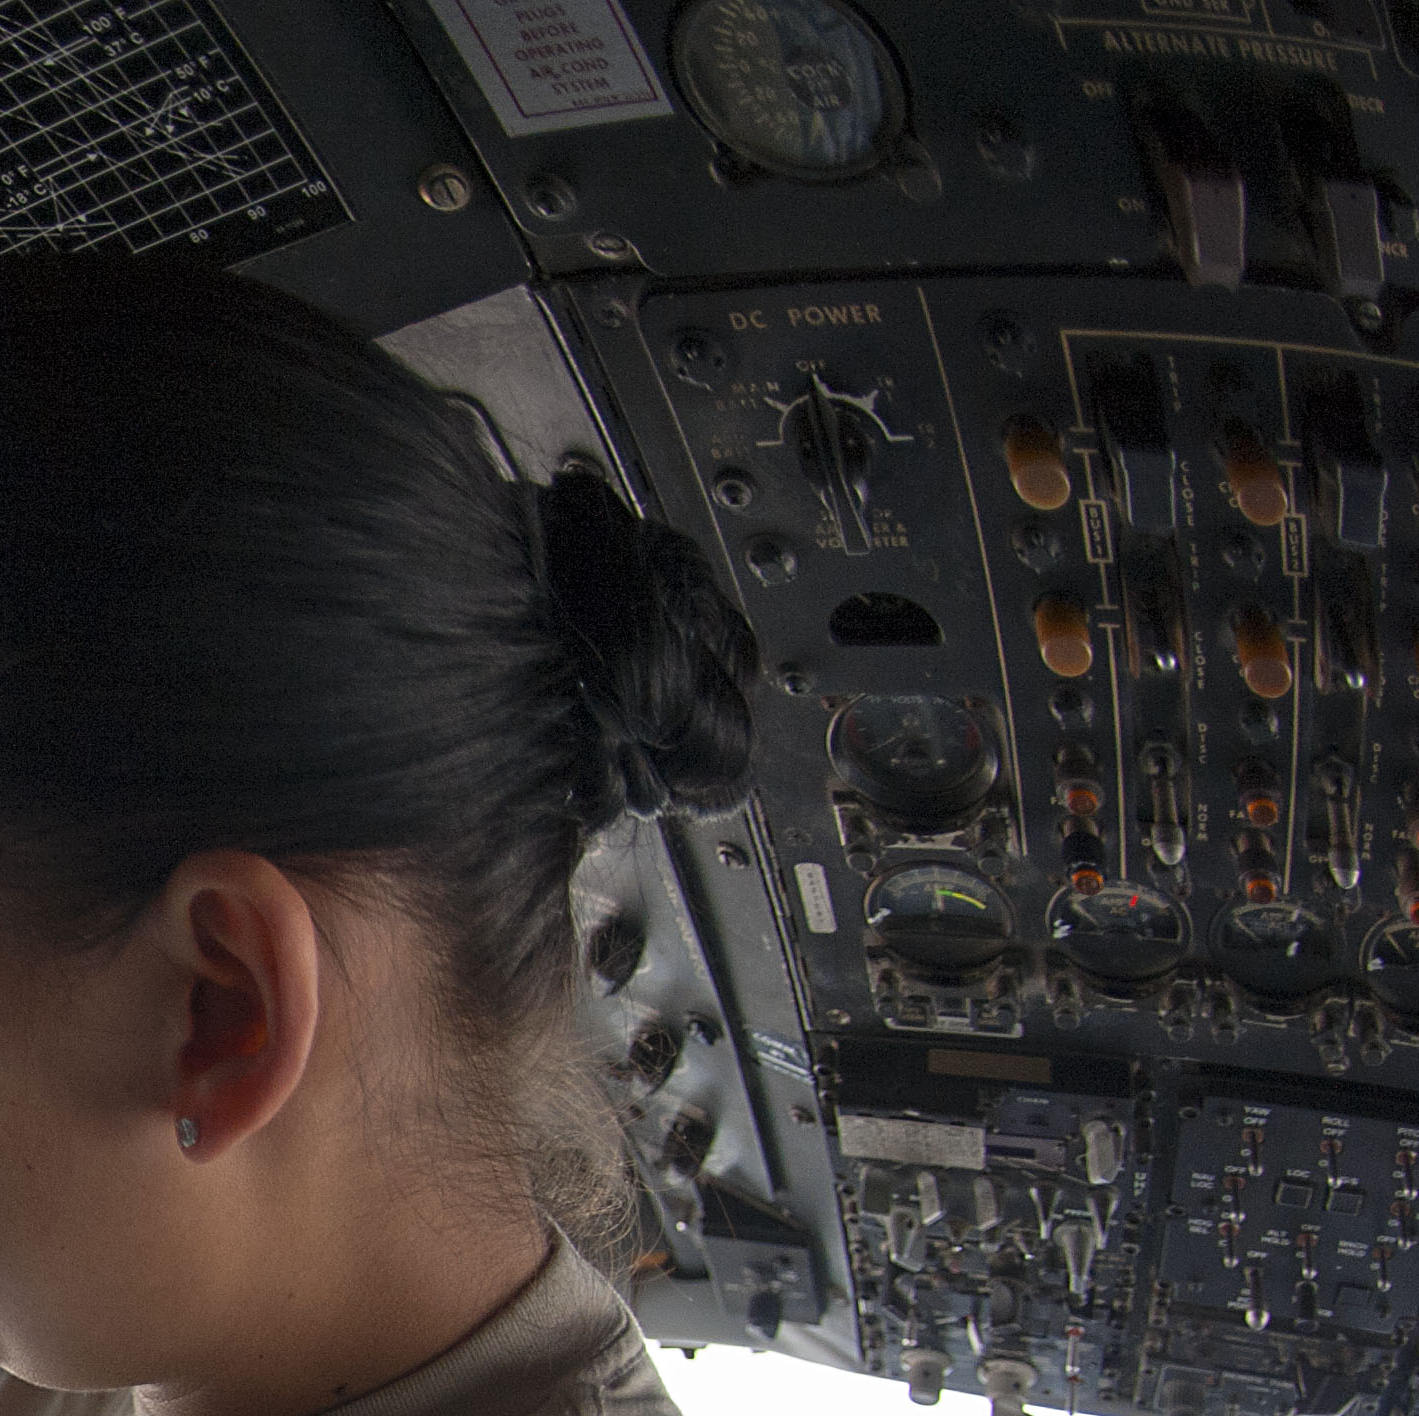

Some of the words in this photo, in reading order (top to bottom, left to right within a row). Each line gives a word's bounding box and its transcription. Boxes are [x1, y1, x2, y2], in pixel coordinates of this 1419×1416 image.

[520, 22, 579, 41] BEFORE
[514, 37, 606, 61] OPERATING
[1102, 29, 1234, 60] ALTERNATE
[1238, 39, 1339, 72] PRESSURE
[560, 58, 610, 75] COND
[551, 77, 611, 96] SYSTEM
[301, 181, 327, 198] 100
[247, 206, 267, 221] 90
[729, 309, 767, 331] DC
[787, 303, 883, 328] POWER
[1179, 460, 1195, 527] CLOSE
[1194, 631, 1207, 689] CLOSE
